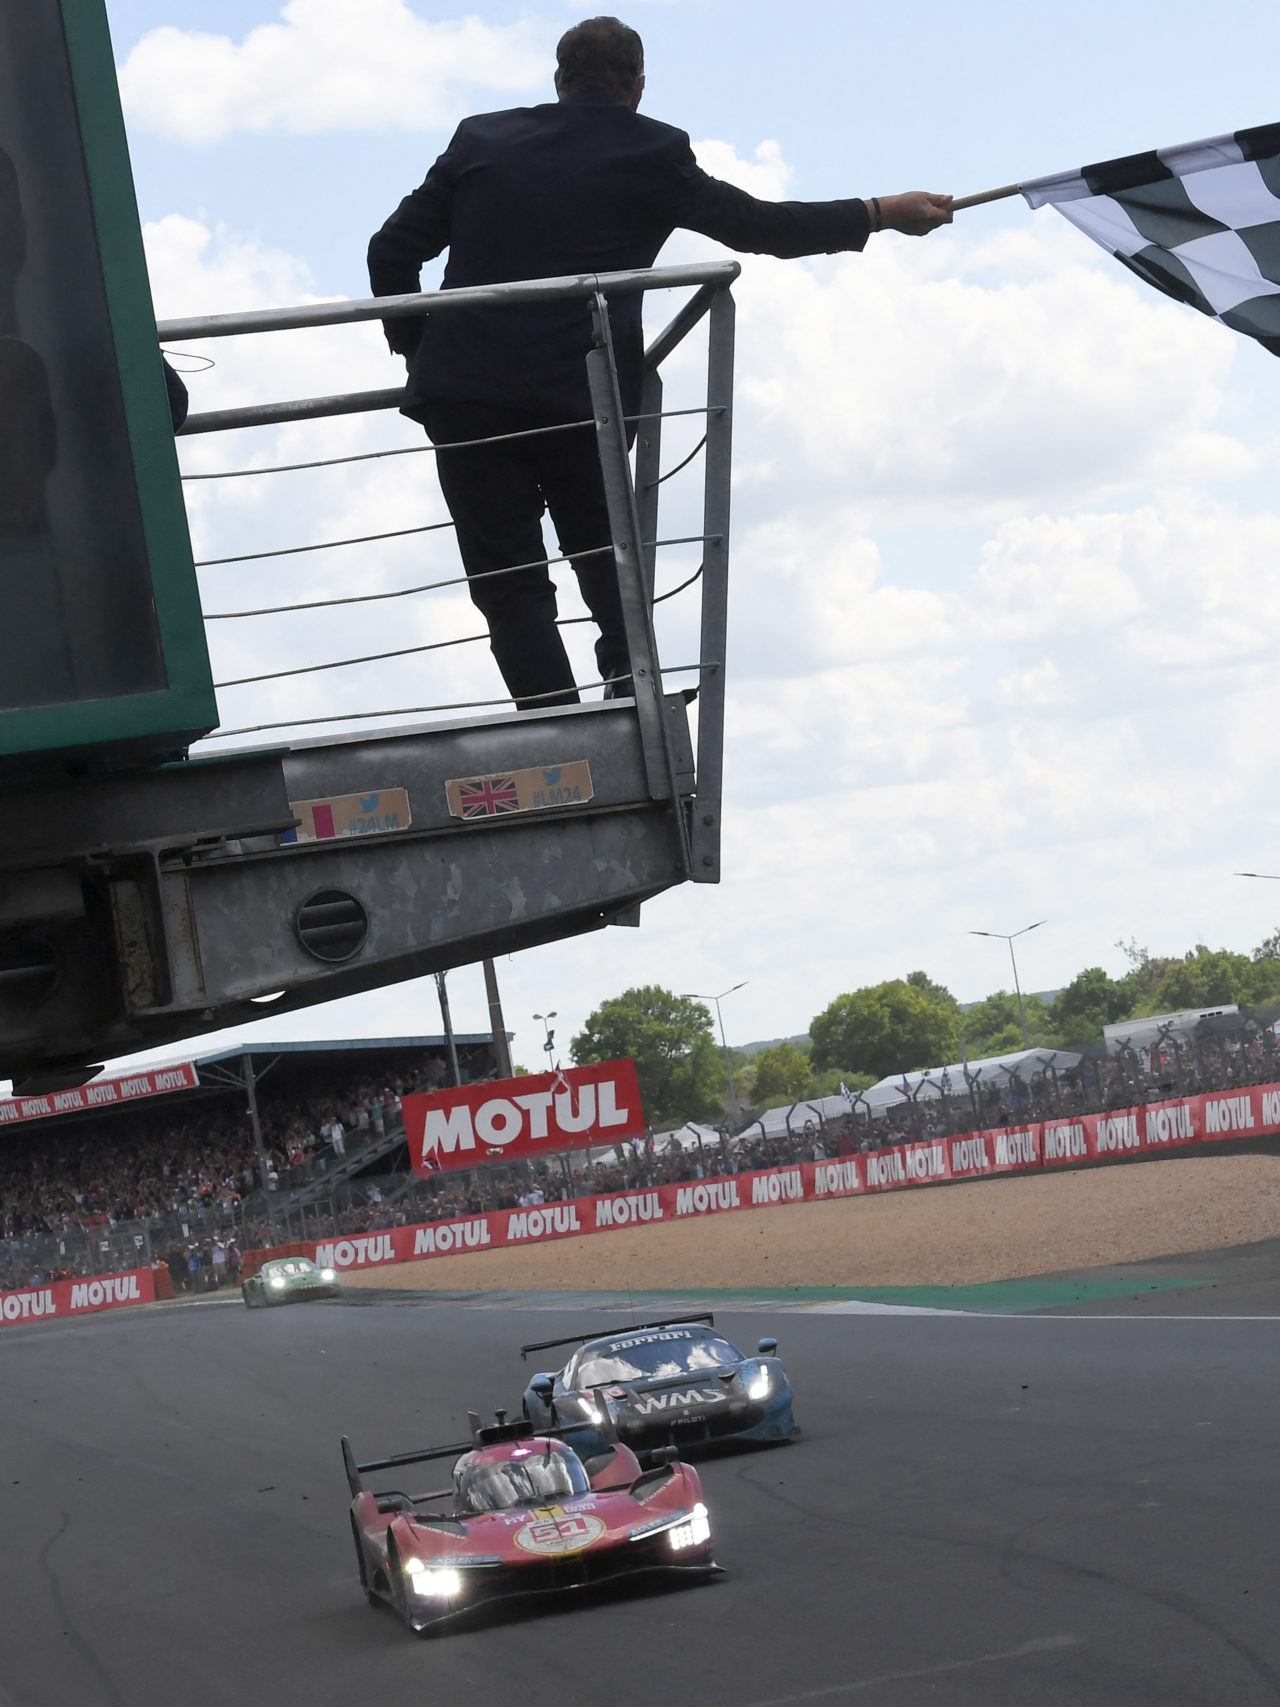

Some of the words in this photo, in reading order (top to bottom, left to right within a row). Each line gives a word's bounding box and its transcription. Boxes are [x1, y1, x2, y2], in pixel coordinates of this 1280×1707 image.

[532, 785, 582, 807] #LM24
[349, 813, 400, 835] #24LM
[21, 1099, 51, 1117] MOTUL
[54, 1091, 84, 1111] MOTUL
[87, 1084, 117, 1104] MOTUL
[120, 1077, 152, 1097] MOTUL
[155, 1070, 187, 1090] MOTUL
[422, 1080, 629, 1156] MOTUL
[315, 1235, 395, 1268] MOTUL
[414, 1219, 490, 1255] MOTUL
[507, 1205, 580, 1239] MOTUL
[596, 1192, 663, 1227] MOTUL
[676, 1181, 740, 1215] MOTUL
[752, 1170, 804, 1204] MOTUL
[815, 1161, 859, 1194] MOTUL
[867, 1153, 906, 1186] MOTUL
[906, 1146, 945, 1178] MOTUL
[952, 1138, 988, 1171] MOTUL
[995, 1131, 1036, 1165] MOTUL
[1045, 1125, 1087, 1159] MOTUL
[1097, 1115, 1140, 1152] MOTUL
[1146, 1105, 1194, 1144] MOTUL
[1206, 1096, 1255, 1133] MOTUL
[0, 1290, 56, 1321] OTUL
[71, 1275, 140, 1309] MOTUL
[609, 1330, 693, 1352] Ferrari
[633, 1388, 727, 1415] WMS
[532, 1520, 586, 1540] 51
